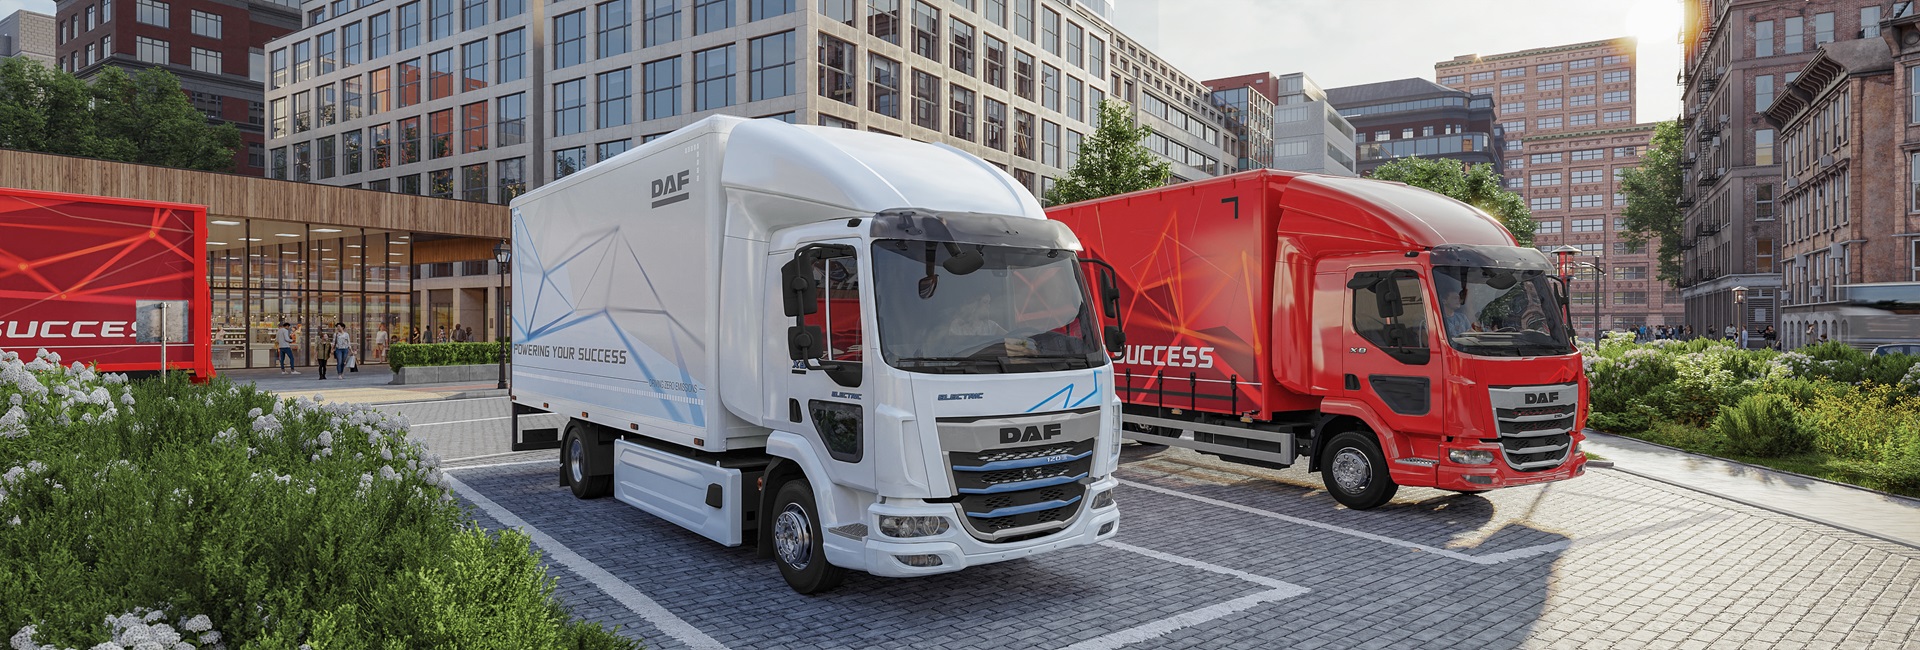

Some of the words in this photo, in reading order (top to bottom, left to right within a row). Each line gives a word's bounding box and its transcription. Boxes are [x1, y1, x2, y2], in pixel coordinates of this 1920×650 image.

[651, 169, 690, 199] DAF
[0, 320, 137, 338] UCCE
[513, 343, 550, 358] POWERING
[552, 346, 575, 360] YOUR
[578, 347, 627, 365] SUCCESS
[831, 391, 862, 400] ELECTRIC
[937, 392, 984, 401] ELECTRIC
[1525, 391, 1559, 404] DAF
[1000, 423, 1062, 444] DAF
